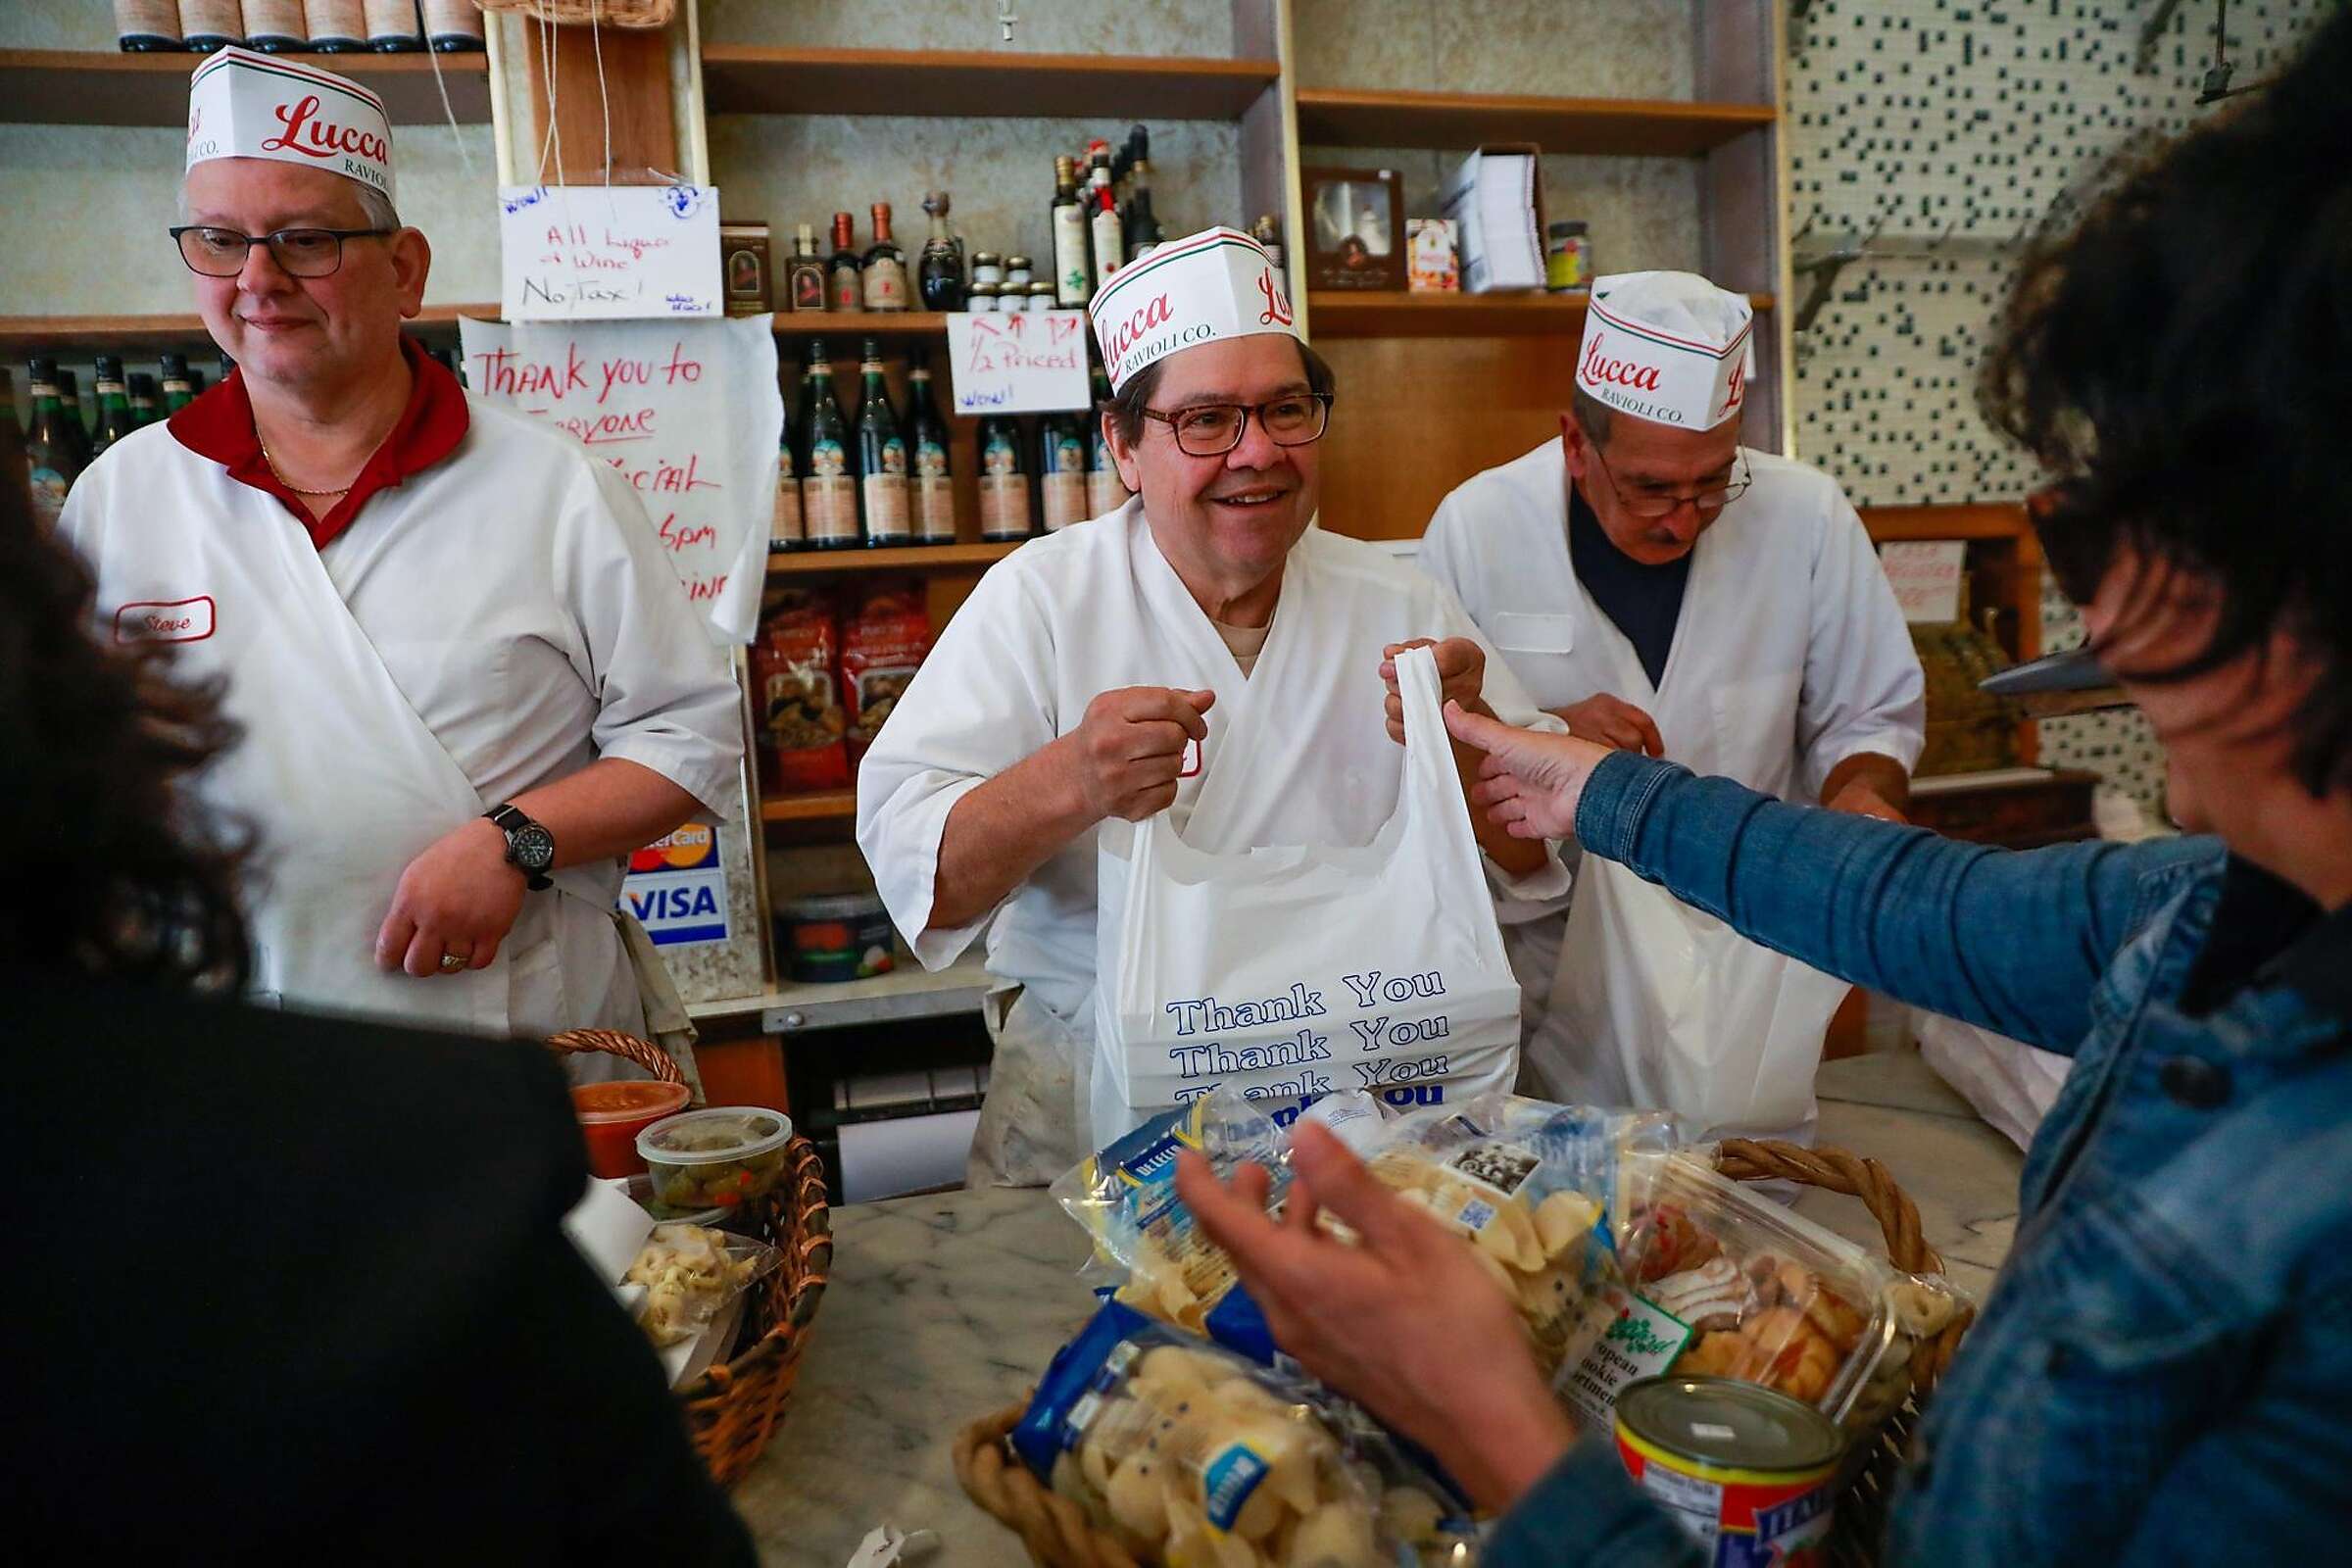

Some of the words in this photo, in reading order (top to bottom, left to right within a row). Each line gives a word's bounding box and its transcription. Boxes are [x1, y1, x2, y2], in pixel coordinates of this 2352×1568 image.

[261, 95, 387, 166] Lucca
[661, 342, 702, 384] to
[1126, 333, 1177, 371] RAVIOLI
[1183, 323, 1216, 344] CO.
[1579, 332, 1661, 392] Lucca
[1600, 387, 1655, 419] RAVIOLI
[1656, 408, 1685, 424] CO.
[628, 885, 718, 921] VISA
[1166, 983, 1327, 1036] Thank
[1342, 970, 1446, 1007] You
[1169, 1029, 1332, 1079] Thank
[1349, 1015, 1450, 1052] You
[1353, 1054, 1449, 1086] You
